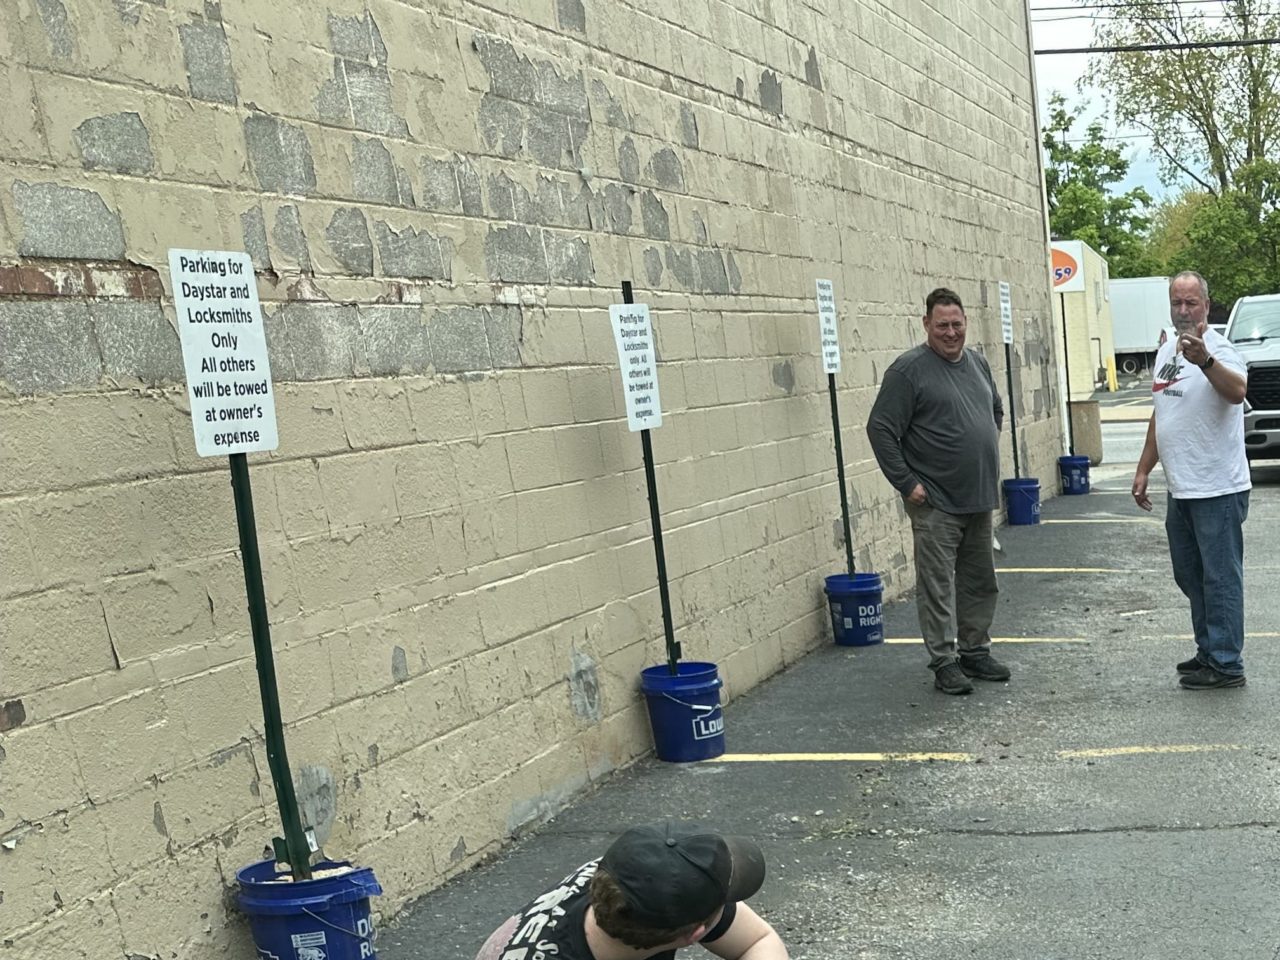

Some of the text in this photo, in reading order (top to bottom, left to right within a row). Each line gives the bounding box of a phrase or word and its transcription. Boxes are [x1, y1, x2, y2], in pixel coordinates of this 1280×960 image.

[180, 256, 243, 276] Parking for
[182, 282, 250, 301] Daystar and
[188, 308, 252, 323] Locksmiths
[212, 332, 238, 351] Only
[202, 357, 255, 372] All others
[193, 379, 268, 398] will be towed
[205, 404, 262, 422] at owner's
[214, 430, 260, 447] expense
[858, 605, 875, 617] DO
